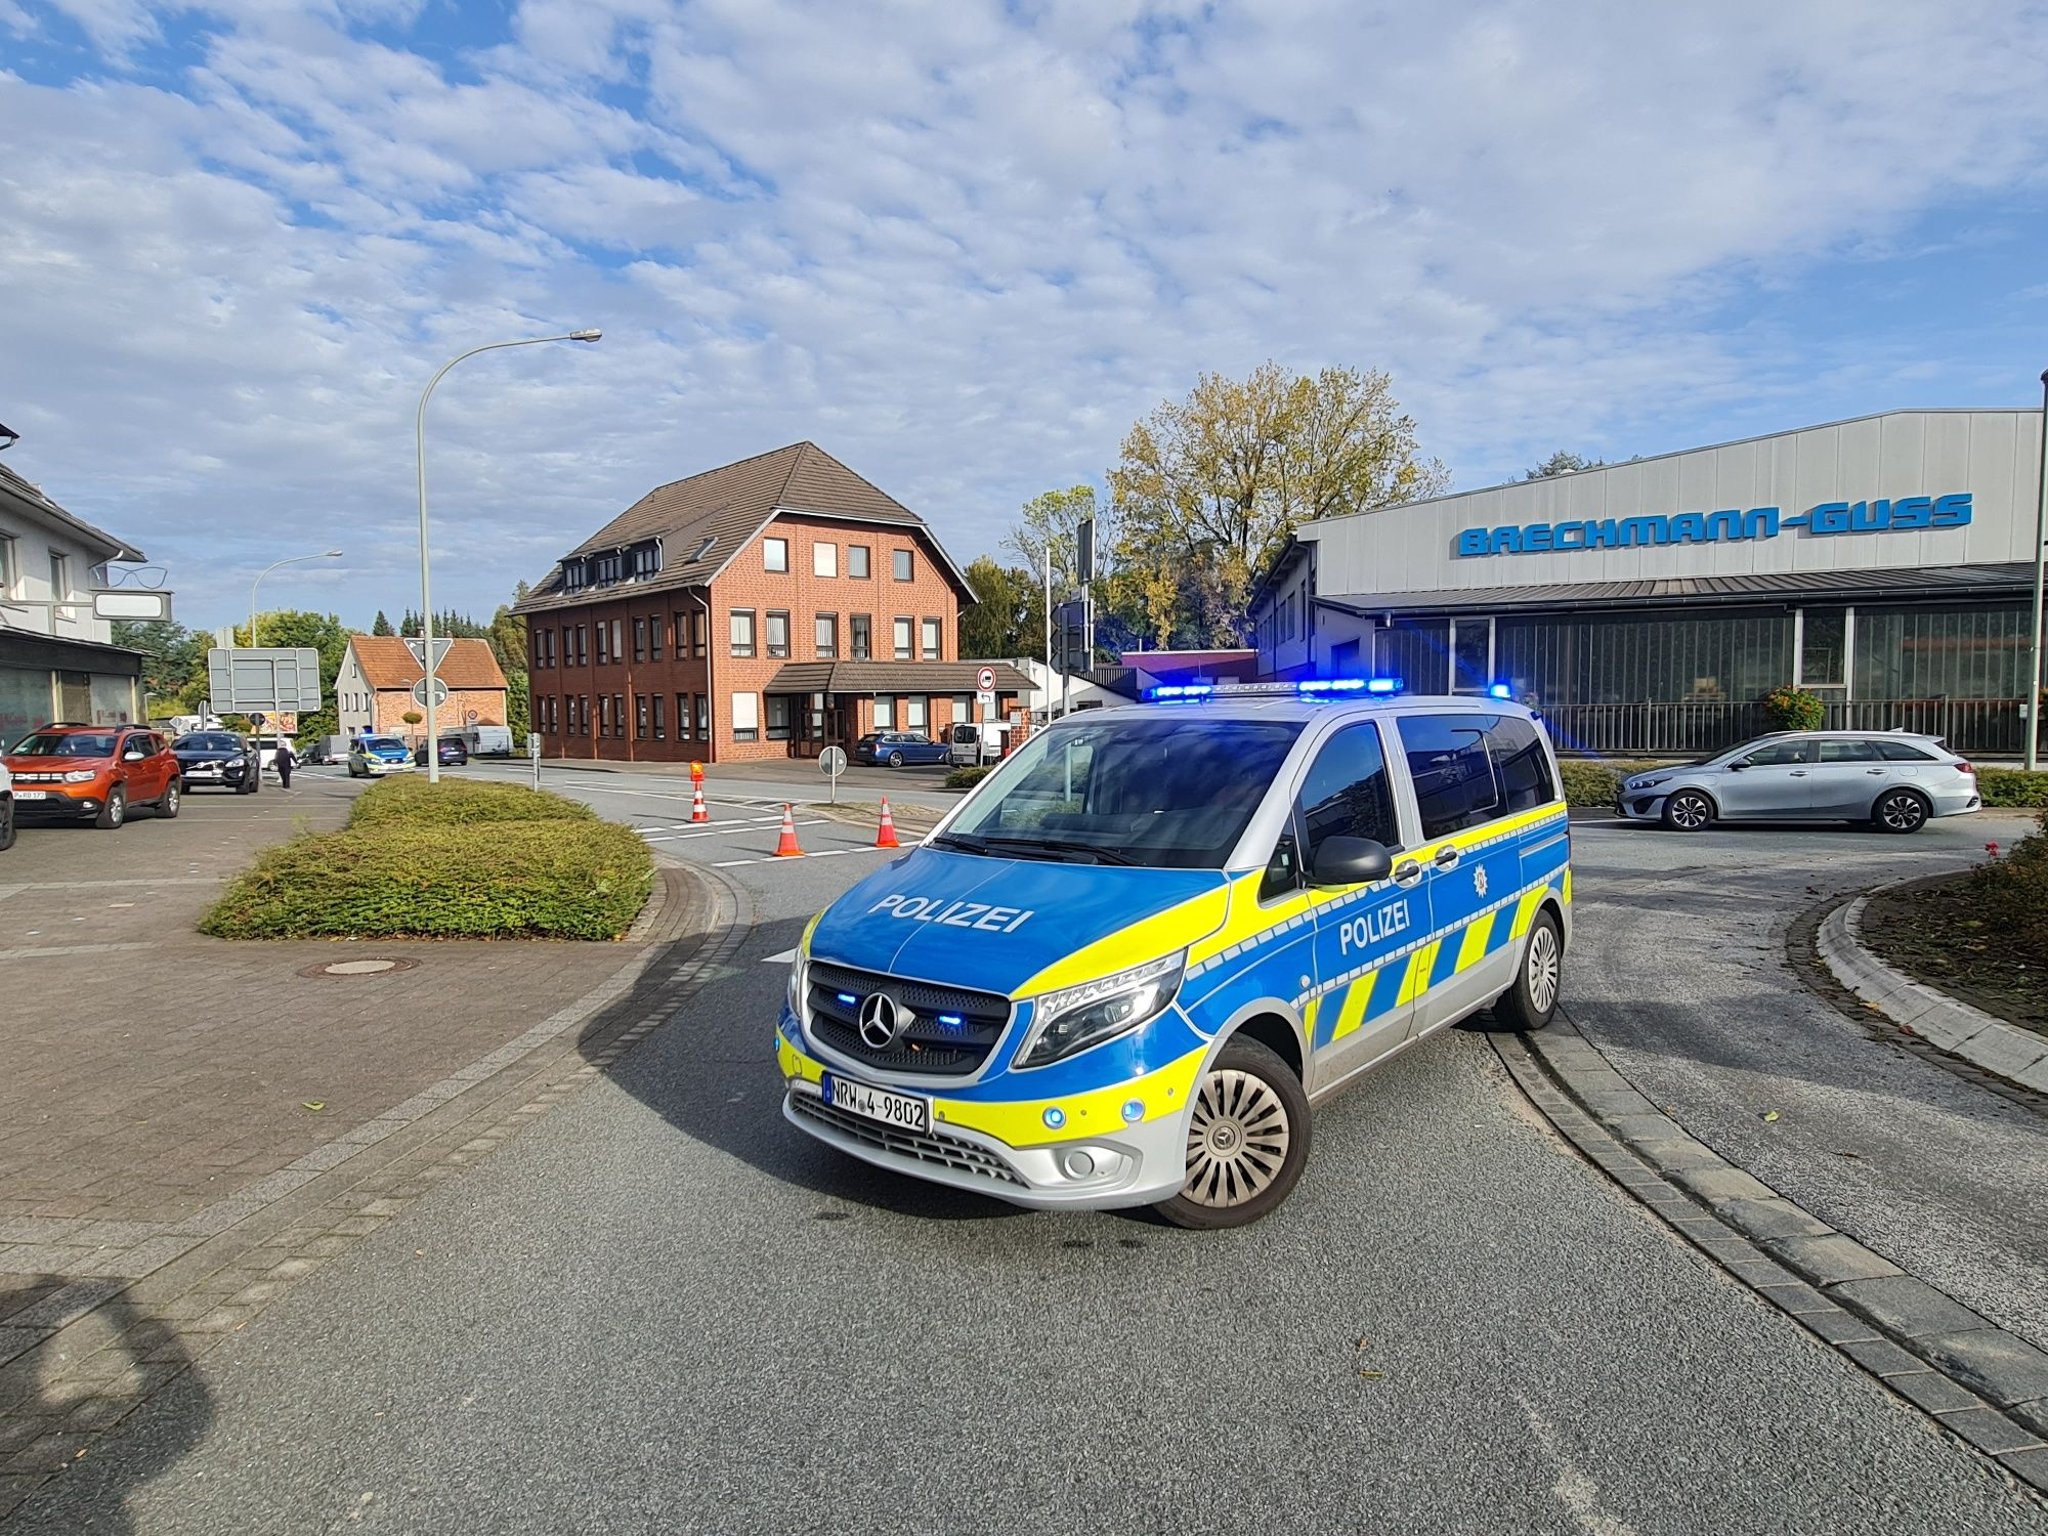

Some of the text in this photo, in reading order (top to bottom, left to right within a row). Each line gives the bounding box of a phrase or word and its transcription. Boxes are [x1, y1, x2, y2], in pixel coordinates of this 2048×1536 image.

[1459, 493, 1973, 556] BRECHMANN-GUSS
[867, 894, 1035, 933] POLIZEI
[1340, 898, 1411, 955] POLIZEI
[832, 1078, 924, 1128] NRW 4-9802
